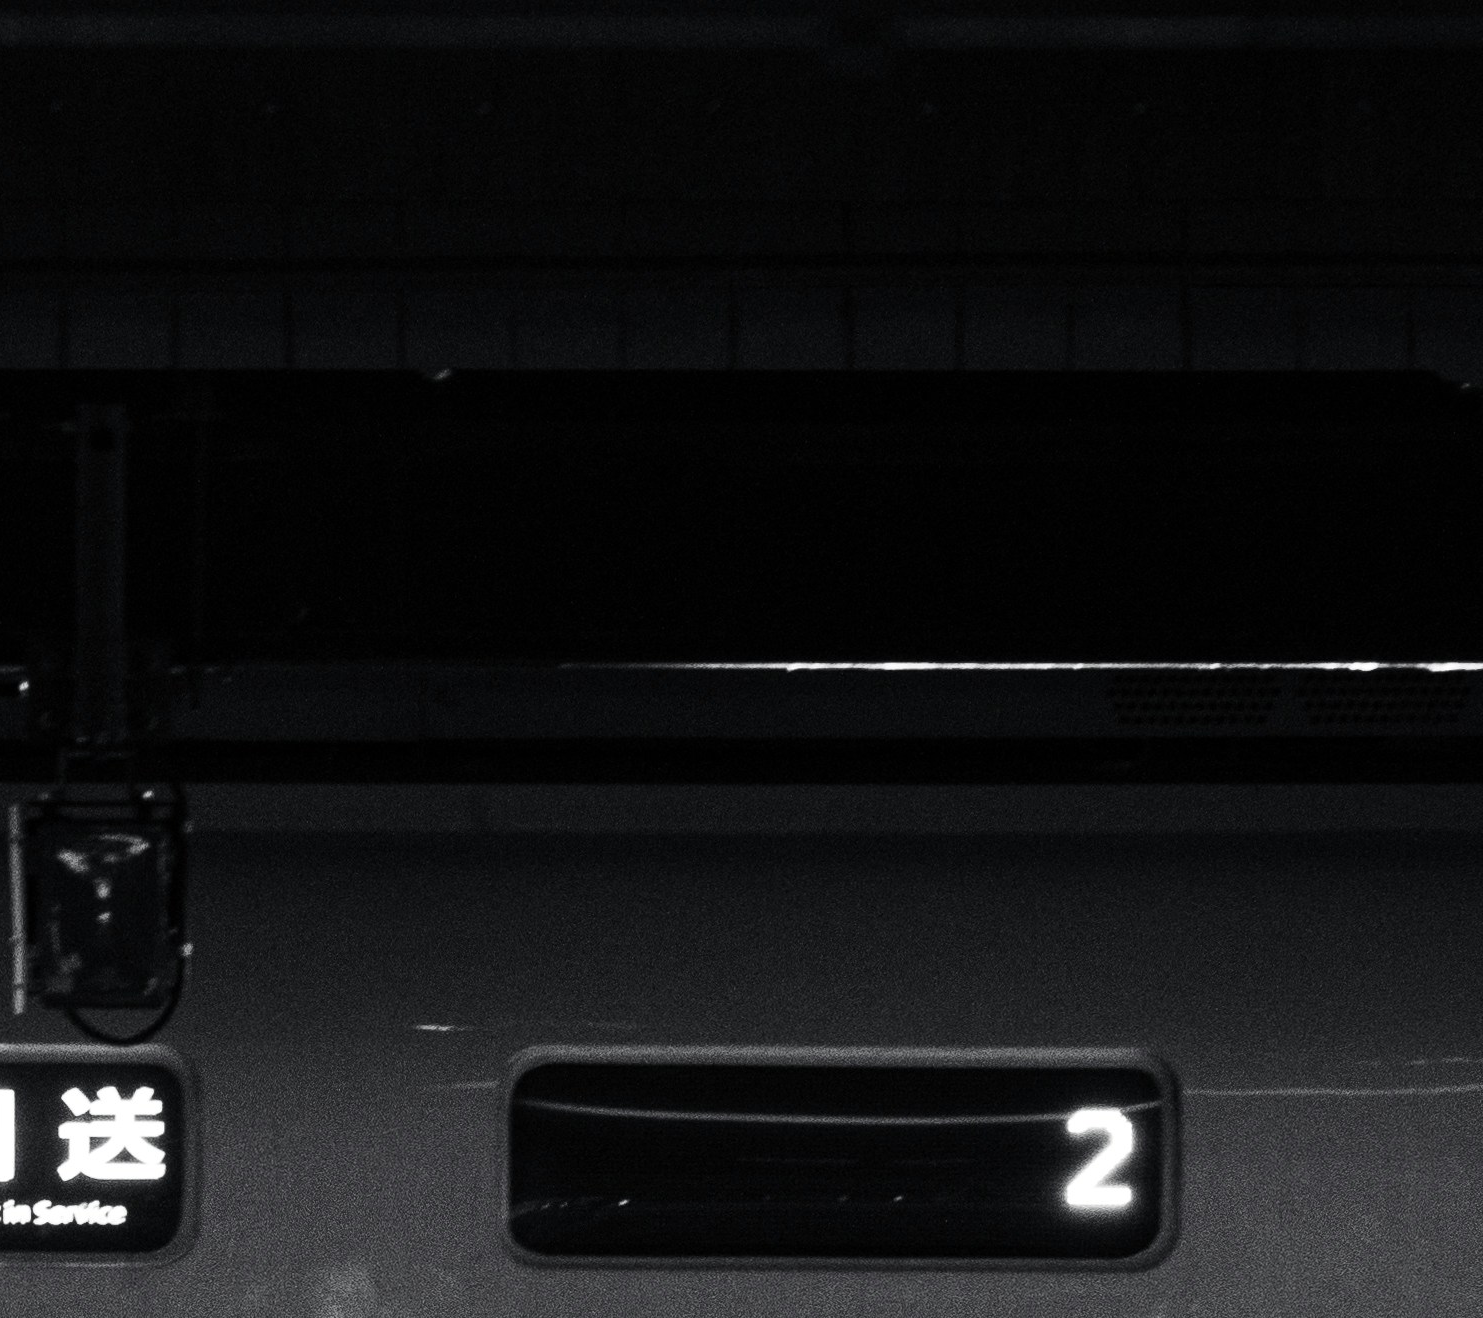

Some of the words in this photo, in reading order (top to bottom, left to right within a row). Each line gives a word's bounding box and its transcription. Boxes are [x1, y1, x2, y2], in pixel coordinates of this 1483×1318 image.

[1063, 1107, 1135, 1212] 2
[2, 1199, 32, 1225] in
[32, 1199, 128, 1225] Service
